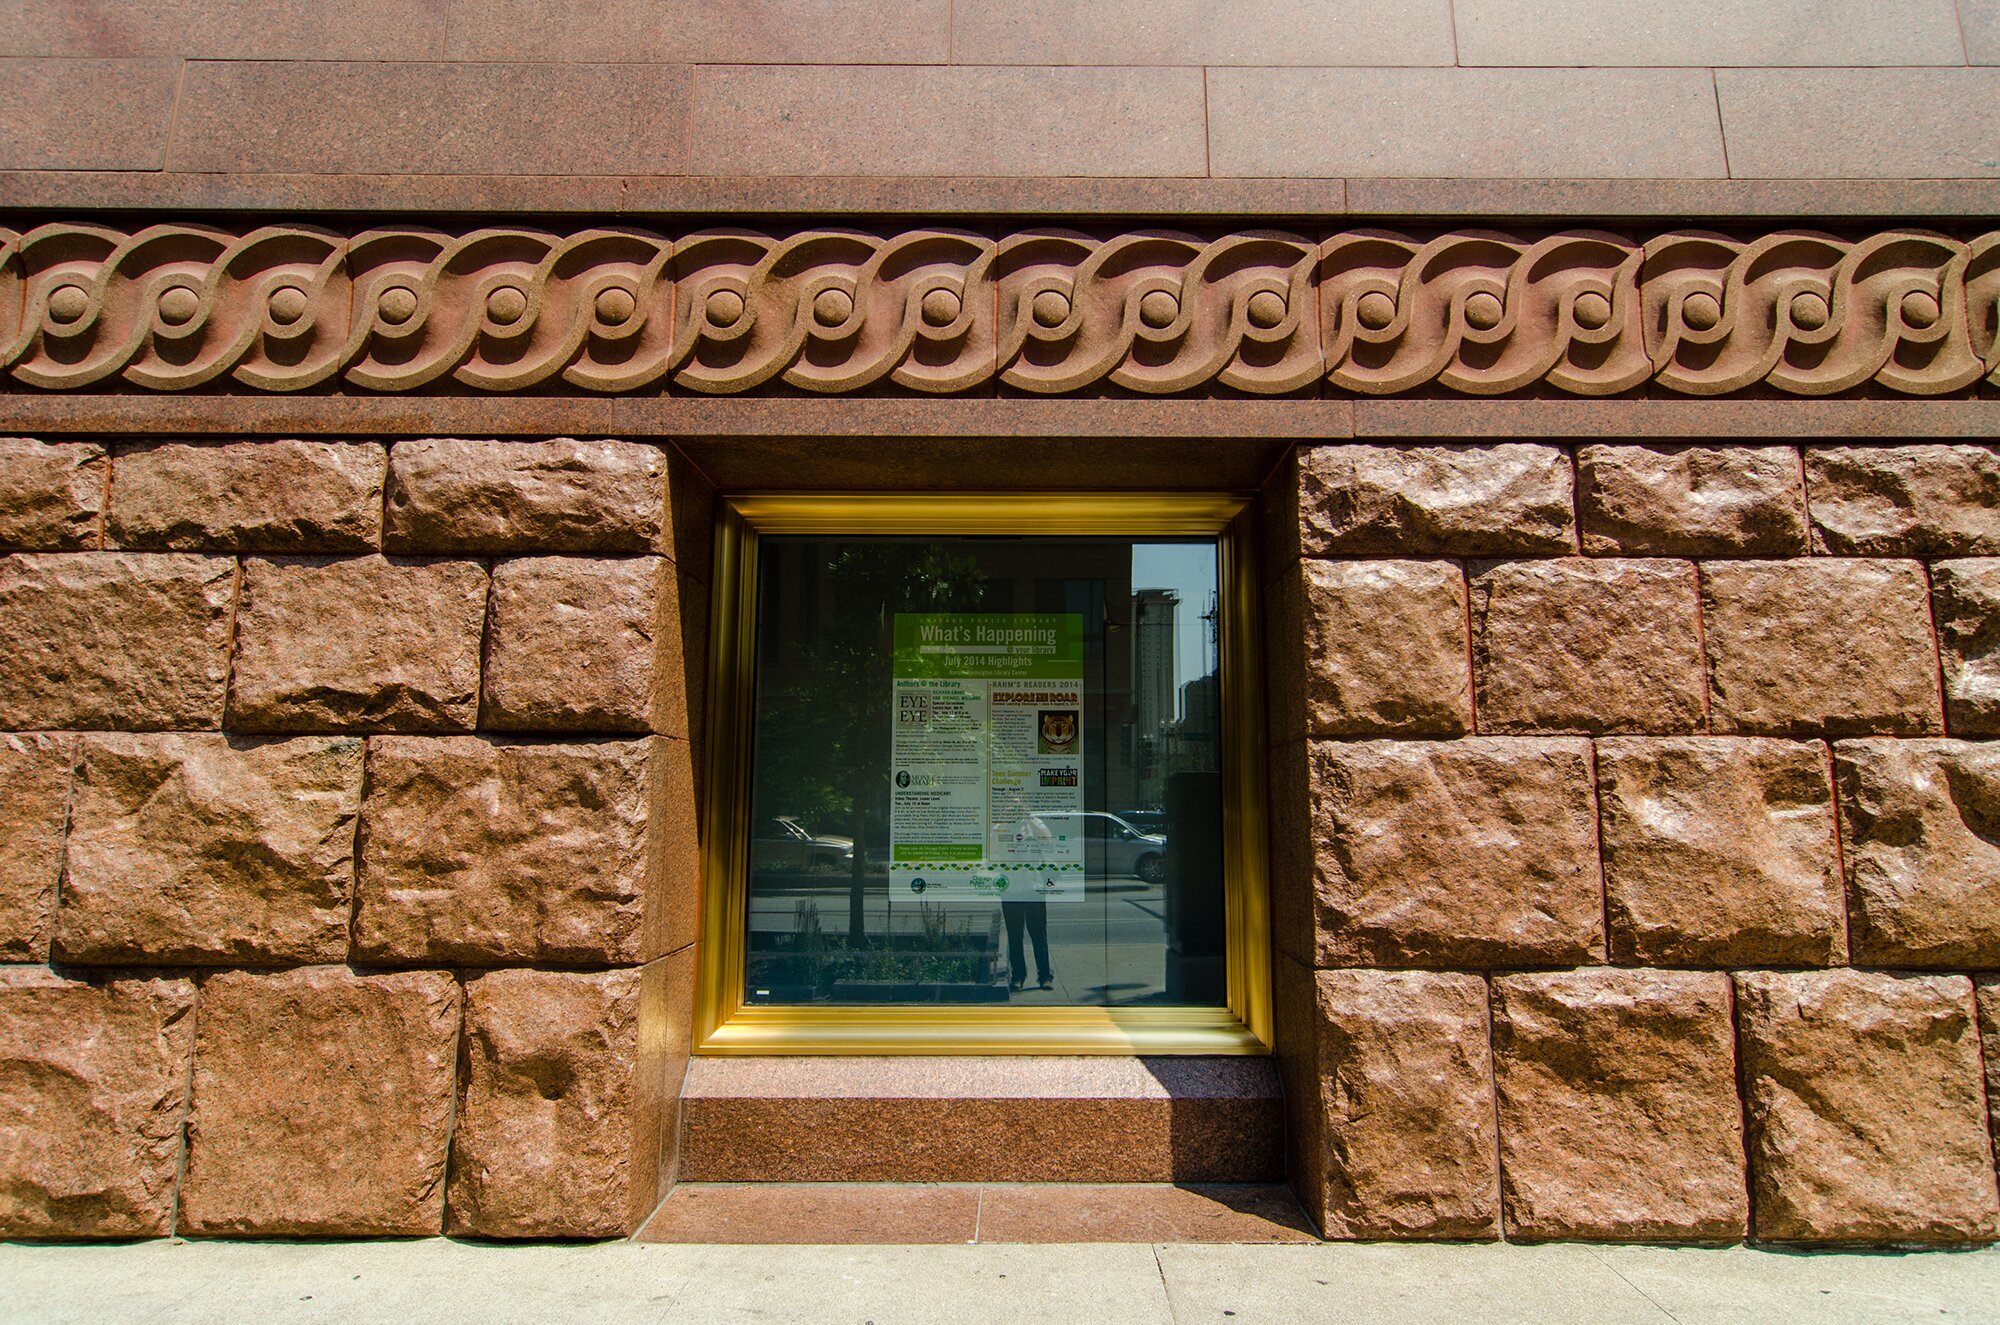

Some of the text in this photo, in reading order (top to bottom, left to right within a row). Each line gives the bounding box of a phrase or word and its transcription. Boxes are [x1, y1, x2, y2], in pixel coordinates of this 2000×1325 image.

[919, 624, 1057, 645] What's Happening
[1031, 646, 1055, 655] library
[943, 655, 1033, 668] July 2014 Highlights
[940, 680, 961, 688] Library
[900, 695, 928, 708] EYE
[992, 692, 1035, 702] EXPLORE
[1049, 692, 1078, 702] ROAR
[900, 710, 928, 722] EYE
[992, 777, 1022, 786] Challenge
[1040, 776, 1077, 786] IMPRINT
